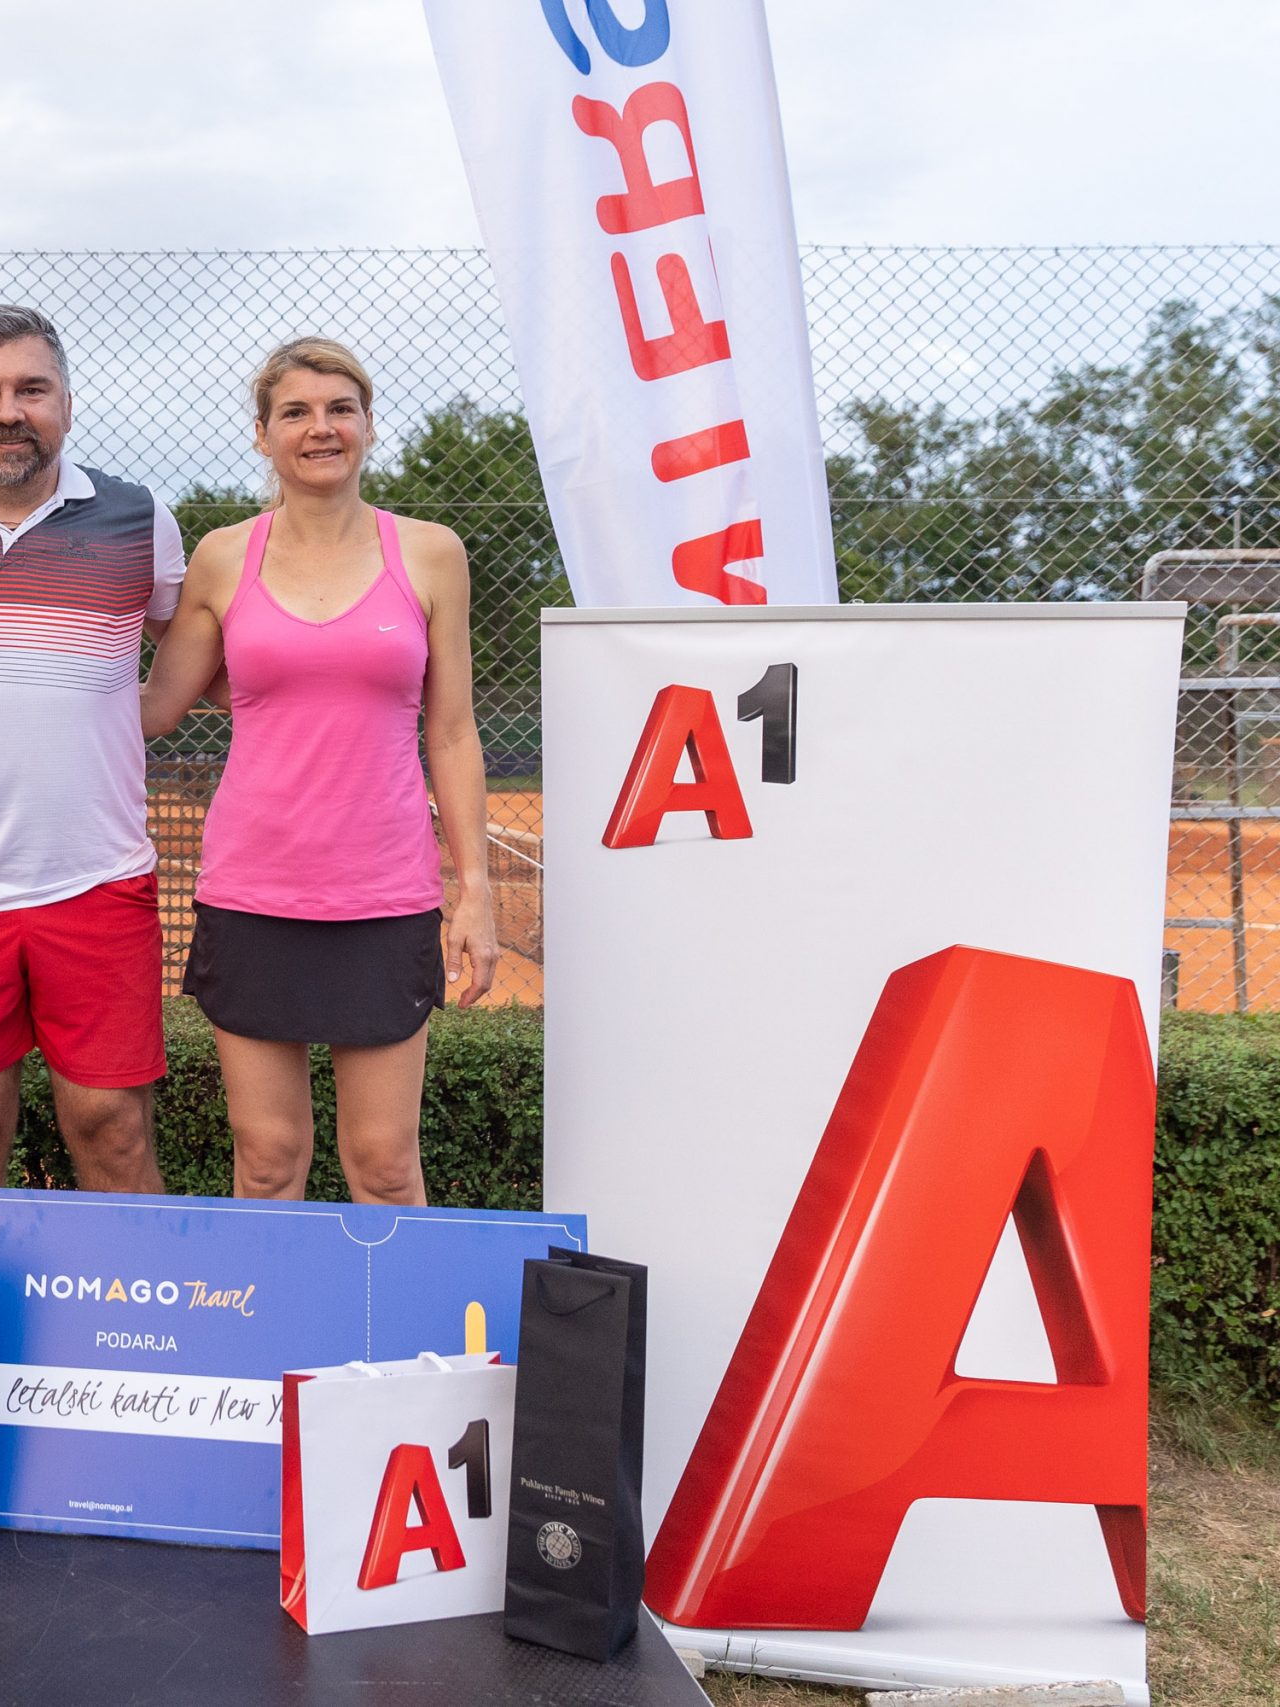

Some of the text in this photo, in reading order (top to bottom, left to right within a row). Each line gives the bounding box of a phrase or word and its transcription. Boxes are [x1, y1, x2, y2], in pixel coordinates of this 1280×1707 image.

[601, 662, 798, 849] A1
[25, 1273, 256, 1317] NOMAGO Travel
[96, 1331, 178, 1352] PODARJA
[6, 1376, 104, 1416] letalski
[209, 1385, 261, 1427] New
[265, 1392, 283, 1427] Y
[68, 1499, 133, 1513] travel@nomago.si
[357, 1418, 492, 1591] A1
[520, 1477, 553, 1493] Puklavec
[554, 1485, 580, 1500] Family
[582, 1491, 606, 1506] Wines
